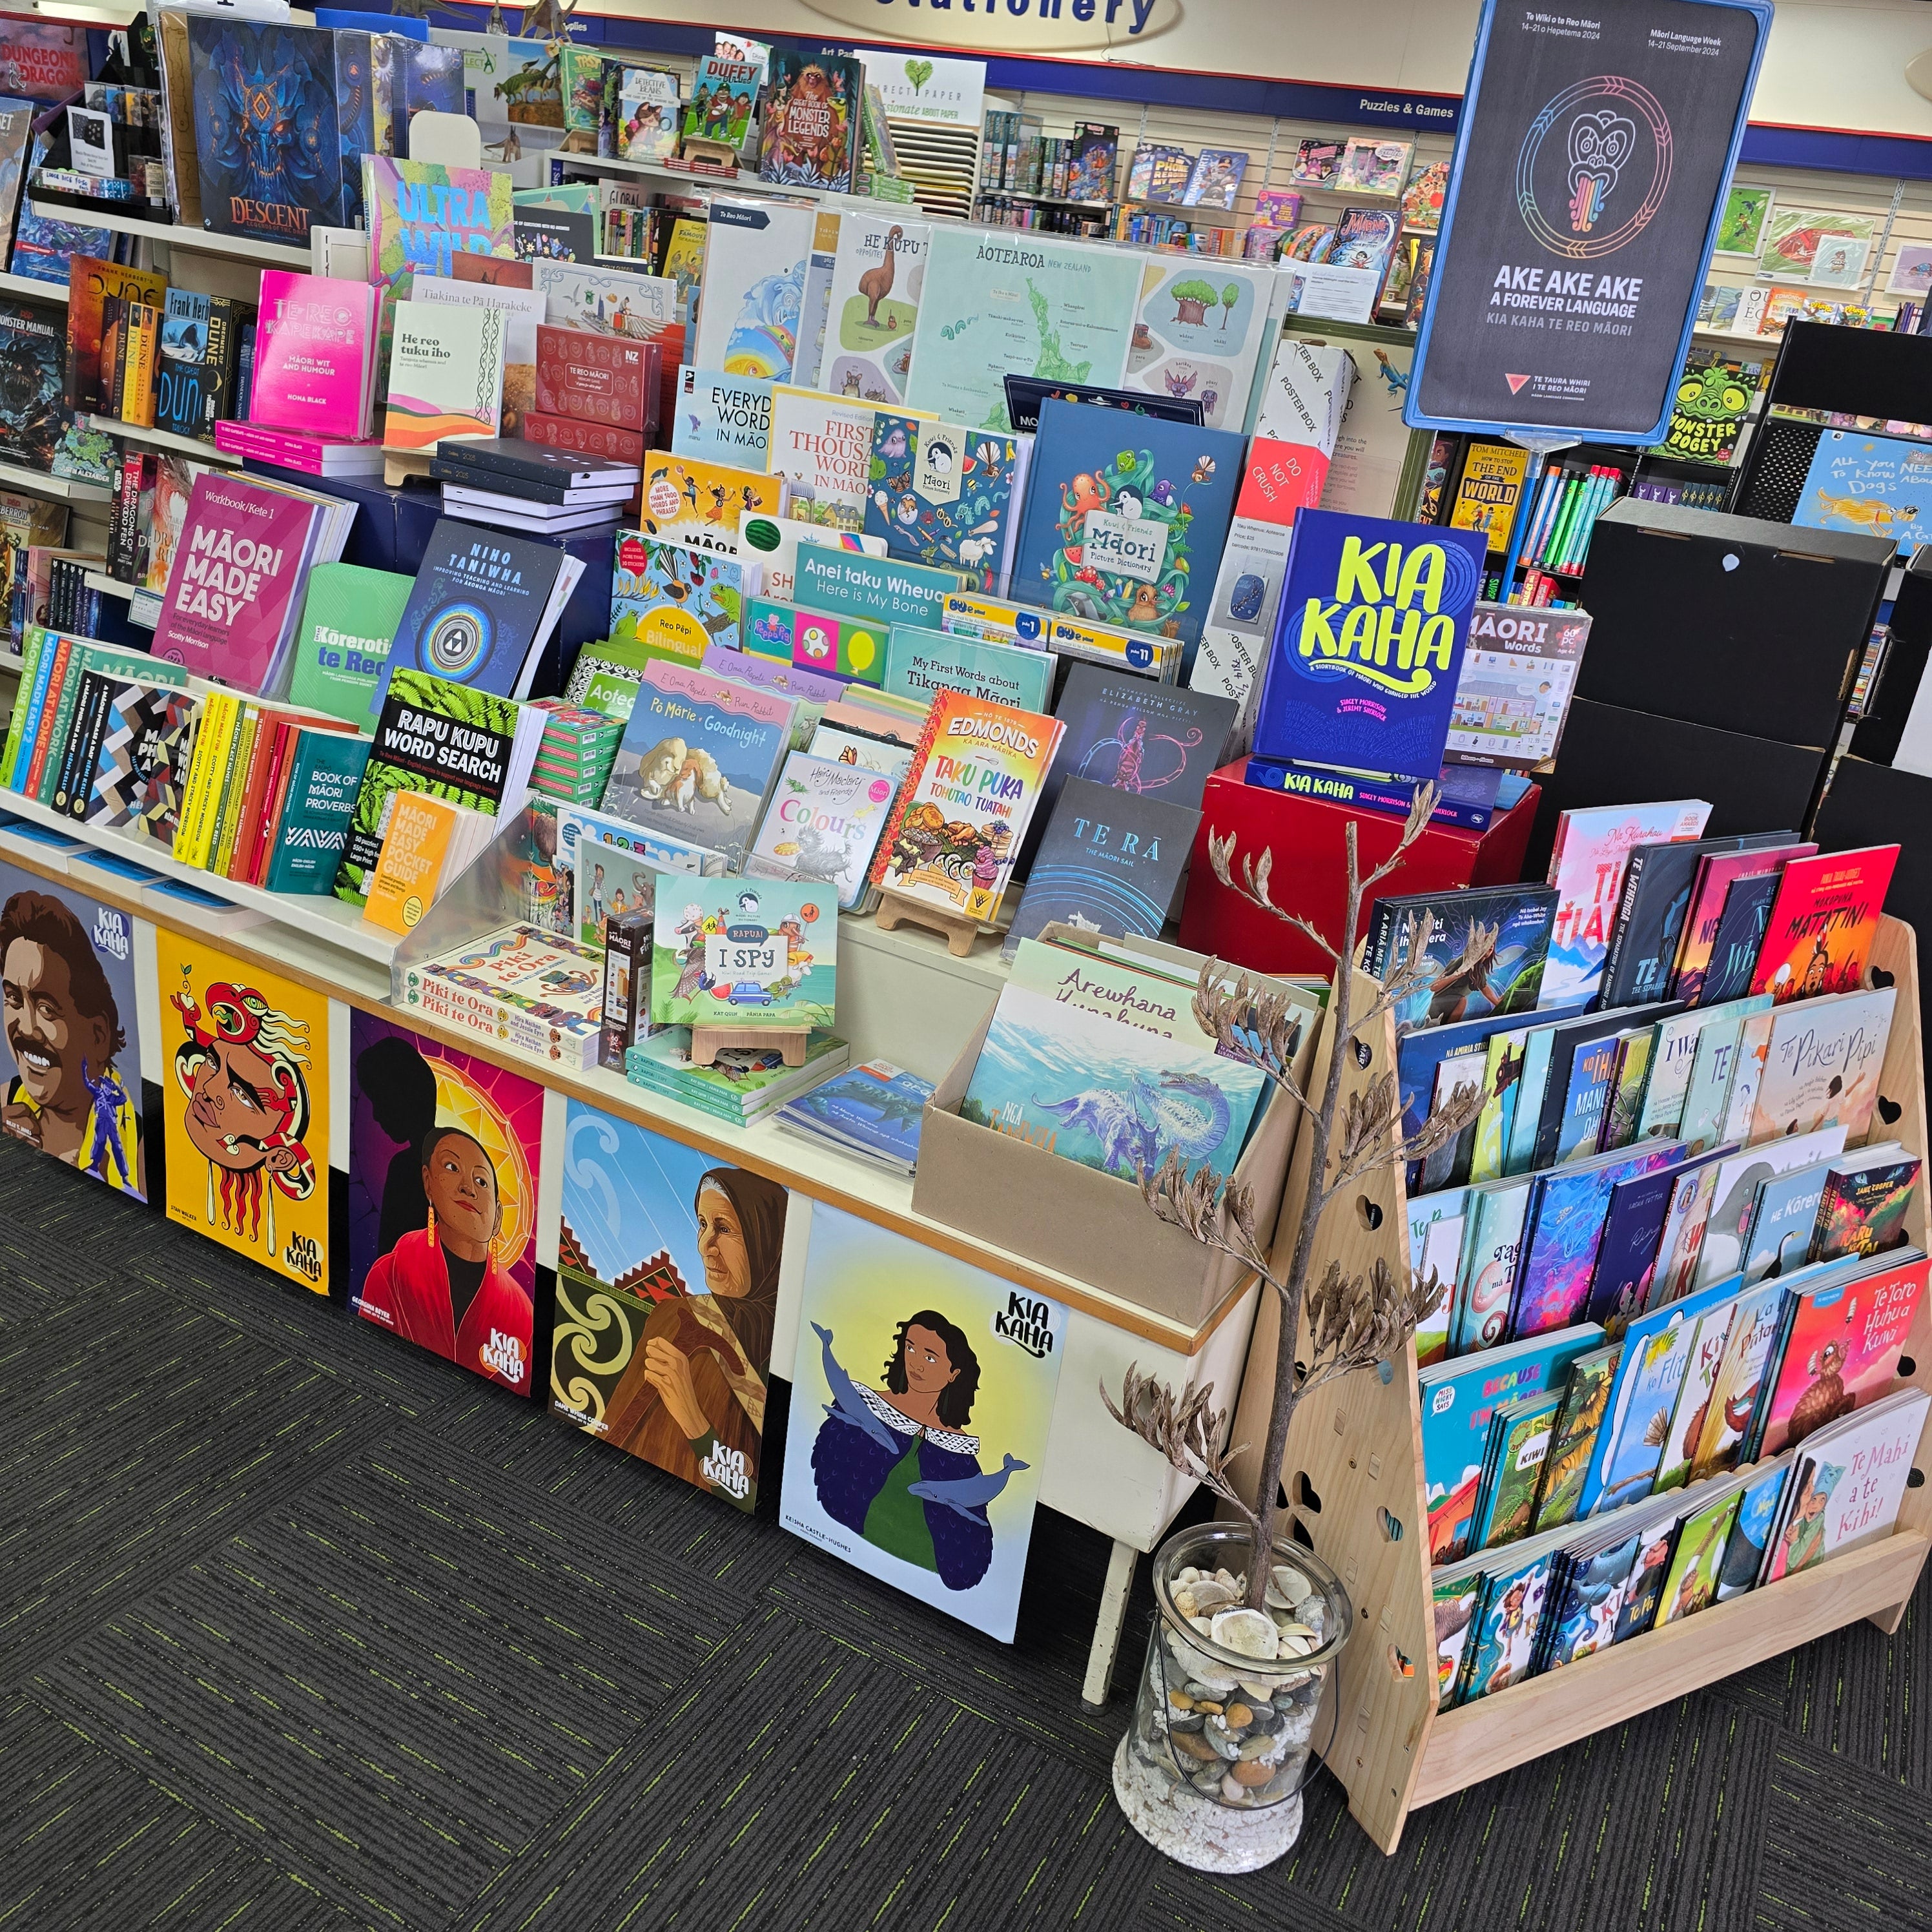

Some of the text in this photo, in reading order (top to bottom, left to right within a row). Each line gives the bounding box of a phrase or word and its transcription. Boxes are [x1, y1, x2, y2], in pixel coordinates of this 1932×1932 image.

[1535, 13, 1550, 23] Wiki
[1557, 15, 1565, 25] te
[1566, 17, 1579, 26] Reo
[1580, 18, 1601, 29] Māori
[1547, 26, 1581, 39] Hepetema
[1582, 30, 1600, 40] 2024
[1650, 28, 1721, 46] Māori Language Week
[1666, 43, 1701, 55] September
[1702, 46, 1719, 56] 2024
[821, 47, 835, 57] Art
[706, 61, 758, 77] DUFFY
[640, 83, 662, 94] BEANS
[805, 90, 818, 102] The
[925, 88, 961, 101] PAPER
[789, 107, 831, 124] MONSTER
[921, 107, 958, 120] ABOUT PAPER
[1360, 99, 1454, 118] Puzzles & Games
[788, 119, 829, 138] LEGENDS
[229, 197, 309, 229] DESCENT
[397, 181, 491, 229] ULTRA
[736, 212, 752, 222] Māori
[976, 246, 1092, 274] AOTEAROA NEW ZEALAND
[1494, 265, 1643, 302] AKE AKE AKE
[422, 288, 533, 313] Tiakina te Pā Harakeke
[1490, 291, 1636, 318] A FOREVER LANGUAGE
[1486, 312, 1632, 336] KIA KAHA TE REO MĀORI
[400, 344, 451, 359] tuku iho
[402, 333, 440, 346] He reo
[283, 362, 335, 376] AND HUMOUR
[289, 355, 313, 365] MĀORI
[1545, 376, 1567, 386] TAURA
[1568, 378, 1590, 387] WHIRI
[1547, 384, 1562, 393] REO
[1563, 384, 1587, 395] MĀORI
[287, 394, 327, 404] HONA BLACK
[1280, 376, 1317, 433] POSTER BOX
[1472, 445, 1528, 458] TOM MITCHELL
[1669, 433, 1721, 452] BOGEY
[1269, 462, 1290, 488] NOT
[1286, 458, 1302, 477] DO
[1472, 462, 1518, 477] THE END
[1251, 466, 1278, 504] CRUSH
[1464, 484, 1517, 503] WORLD
[190, 525, 283, 577] MĀORI
[469, 543, 512, 565] NIHO
[1089, 528, 1157, 563] Māori
[448, 553, 522, 584] TANIWHA
[805, 558, 841, 578] Anei
[841, 568, 882, 589] taku
[1091, 551, 1152, 573] Picture Dictionary
[1334, 535, 1447, 614] KIA
[182, 554, 260, 601] MADE
[174, 583, 245, 626] EASY
[816, 579, 929, 616] Here is My Bone
[167, 630, 209, 650] Scotty Morrison
[1299, 597, 1455, 670] KAHA
[1504, 640, 1542, 653] Words
[1360, 699, 1387, 714] MORRISON
[398, 710, 500, 758] RAPU KUPU
[947, 717, 1040, 759] EDMONDS
[384, 728, 502, 782] WORD SEARCH
[934, 755, 1024, 800] TAKU PUKA
[930, 783, 1012, 817] TOHUTAO TUATAHI
[780, 799, 867, 840] Colours
[1074, 817, 1162, 861] TE RĀ
[1086, 847, 1135, 867] THE MĀORI SAIL
[98, 907, 123, 933] KIA
[1784, 903, 1870, 939] MATATINI
[94, 927, 129, 954] KAHA
[732, 929, 765, 939] RAPUA!
[719, 948, 775, 968] I SPY
[421, 976, 494, 1019] Piki te Ora
[1057, 969, 1177, 1022] Arewhana
[170, 1204, 198, 1222] STAN WALKER
[291, 1231, 317, 1259] KIA
[286, 1251, 322, 1278] KAHA
[351, 1296, 391, 1319] GEORGINA BEYER
[1873, 1279, 1917, 1310] Te Toro
[1008, 1291, 1049, 1329] KIA
[1864, 1304, 1909, 1333] Huhua
[489, 1328, 519, 1359] KIA
[995, 1313, 1054, 1353] KAHA
[1862, 1327, 1897, 1353] Kuwi
[482, 1347, 524, 1380] KAHA
[1482, 1363, 1541, 1398] BECAUSE
[554, 1401, 610, 1431] DAME WHINA COOPER
[712, 1441, 745, 1469] KIA
[1520, 1446, 1545, 1464] KIWI
[1851, 1439, 1909, 1478] Te Mahi
[704, 1461, 749, 1494] KAHA
[1849, 1478, 1878, 1503] a te
[785, 1514, 805, 1528] KEISHA
[1838, 1498, 1882, 1542] Kihi!
